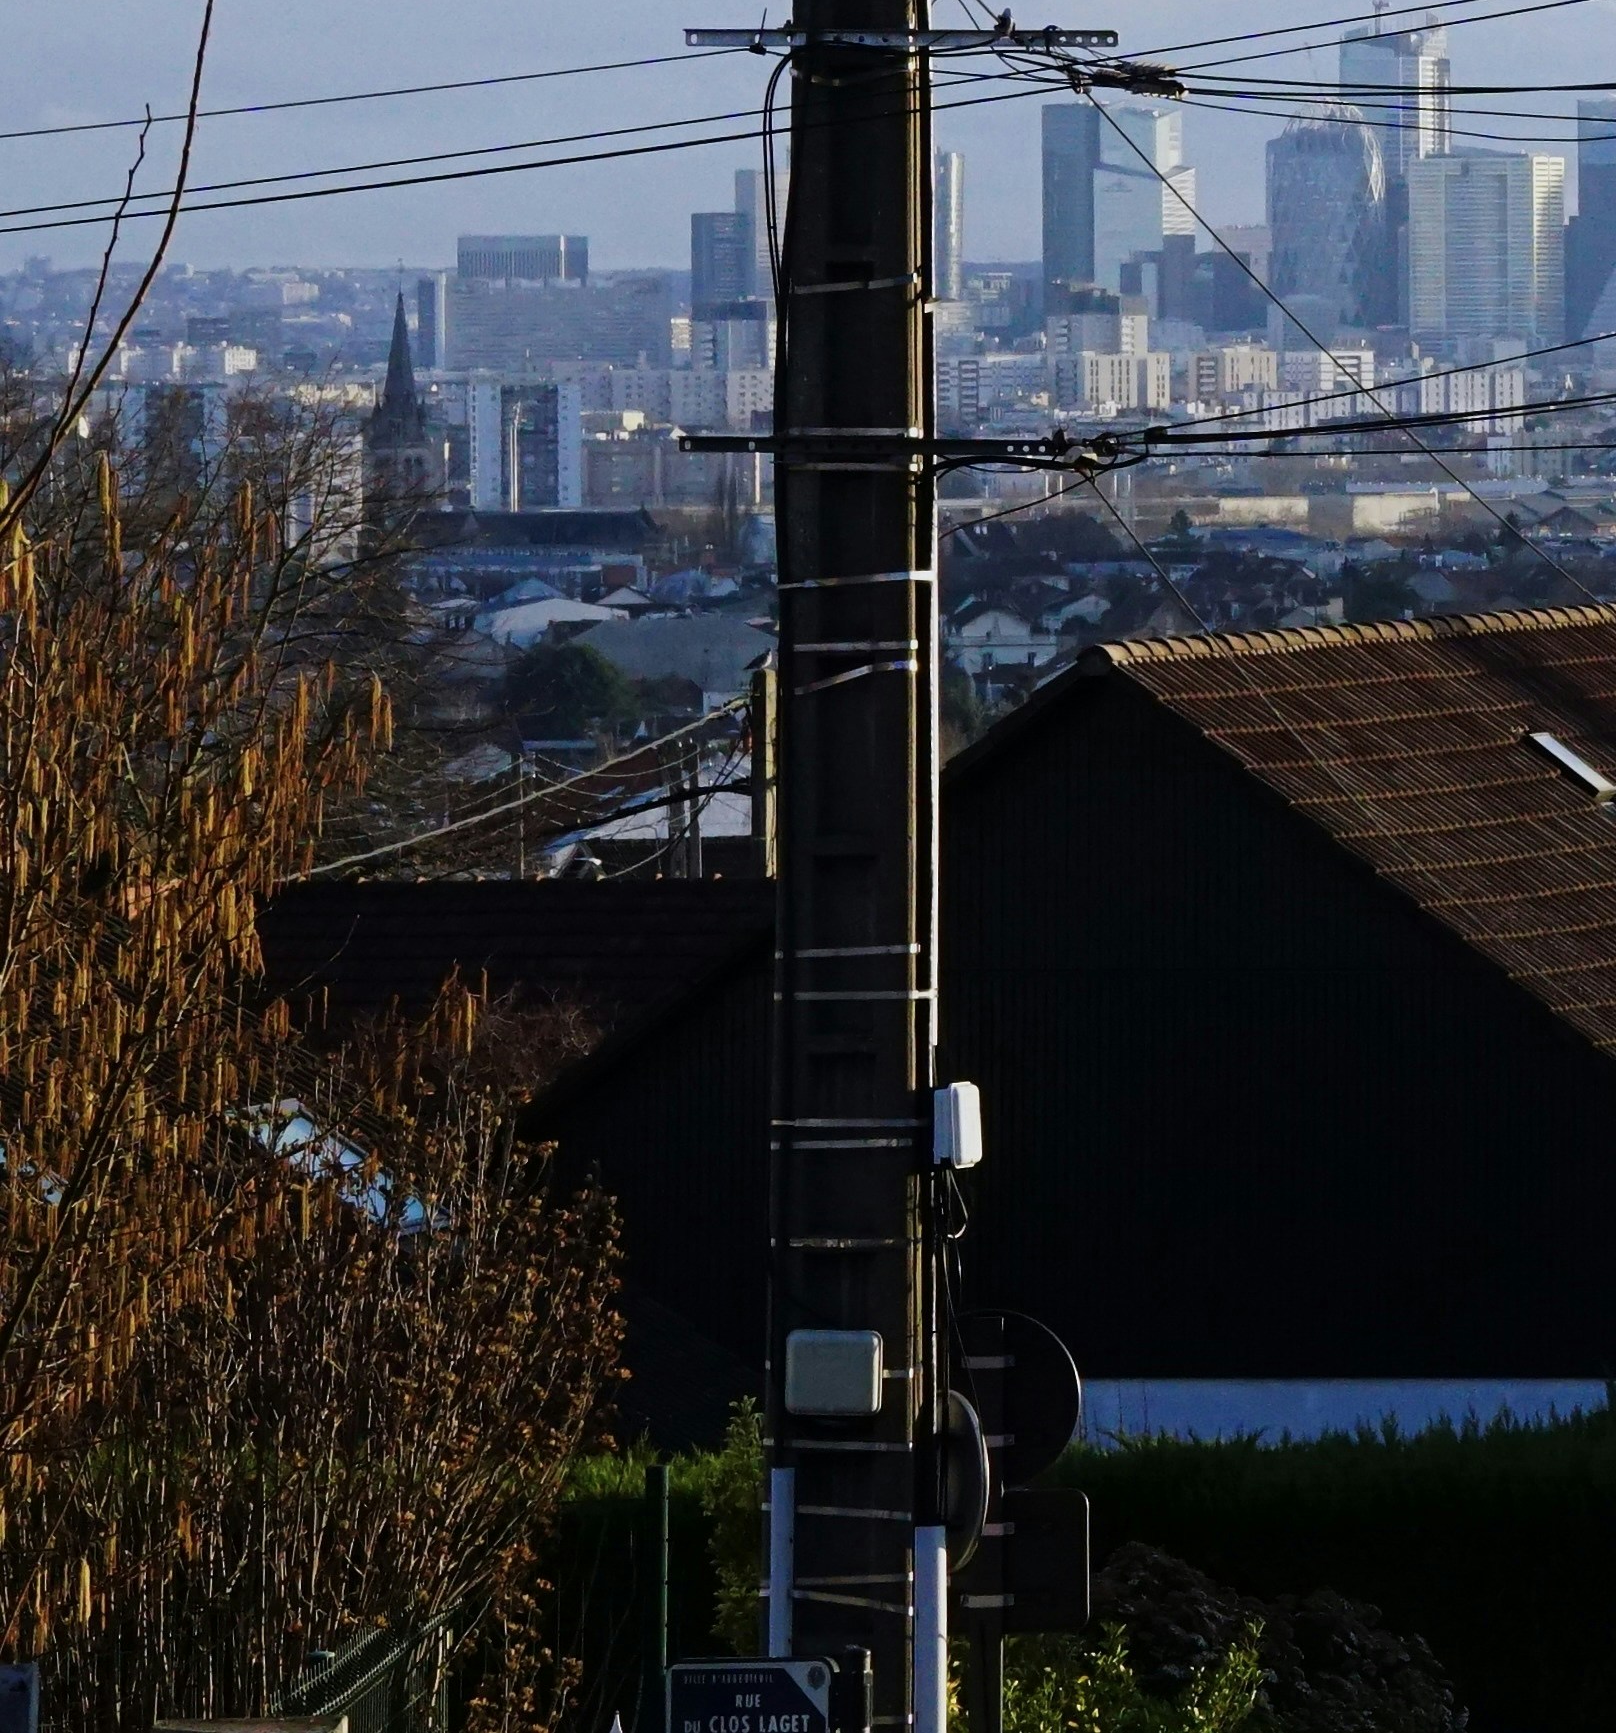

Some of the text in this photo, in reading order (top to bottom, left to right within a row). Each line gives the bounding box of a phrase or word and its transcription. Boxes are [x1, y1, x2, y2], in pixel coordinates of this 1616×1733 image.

[735, 1693, 762, 1708] RUE
[683, 1714, 811, 1733] DU CLOS LAGET
